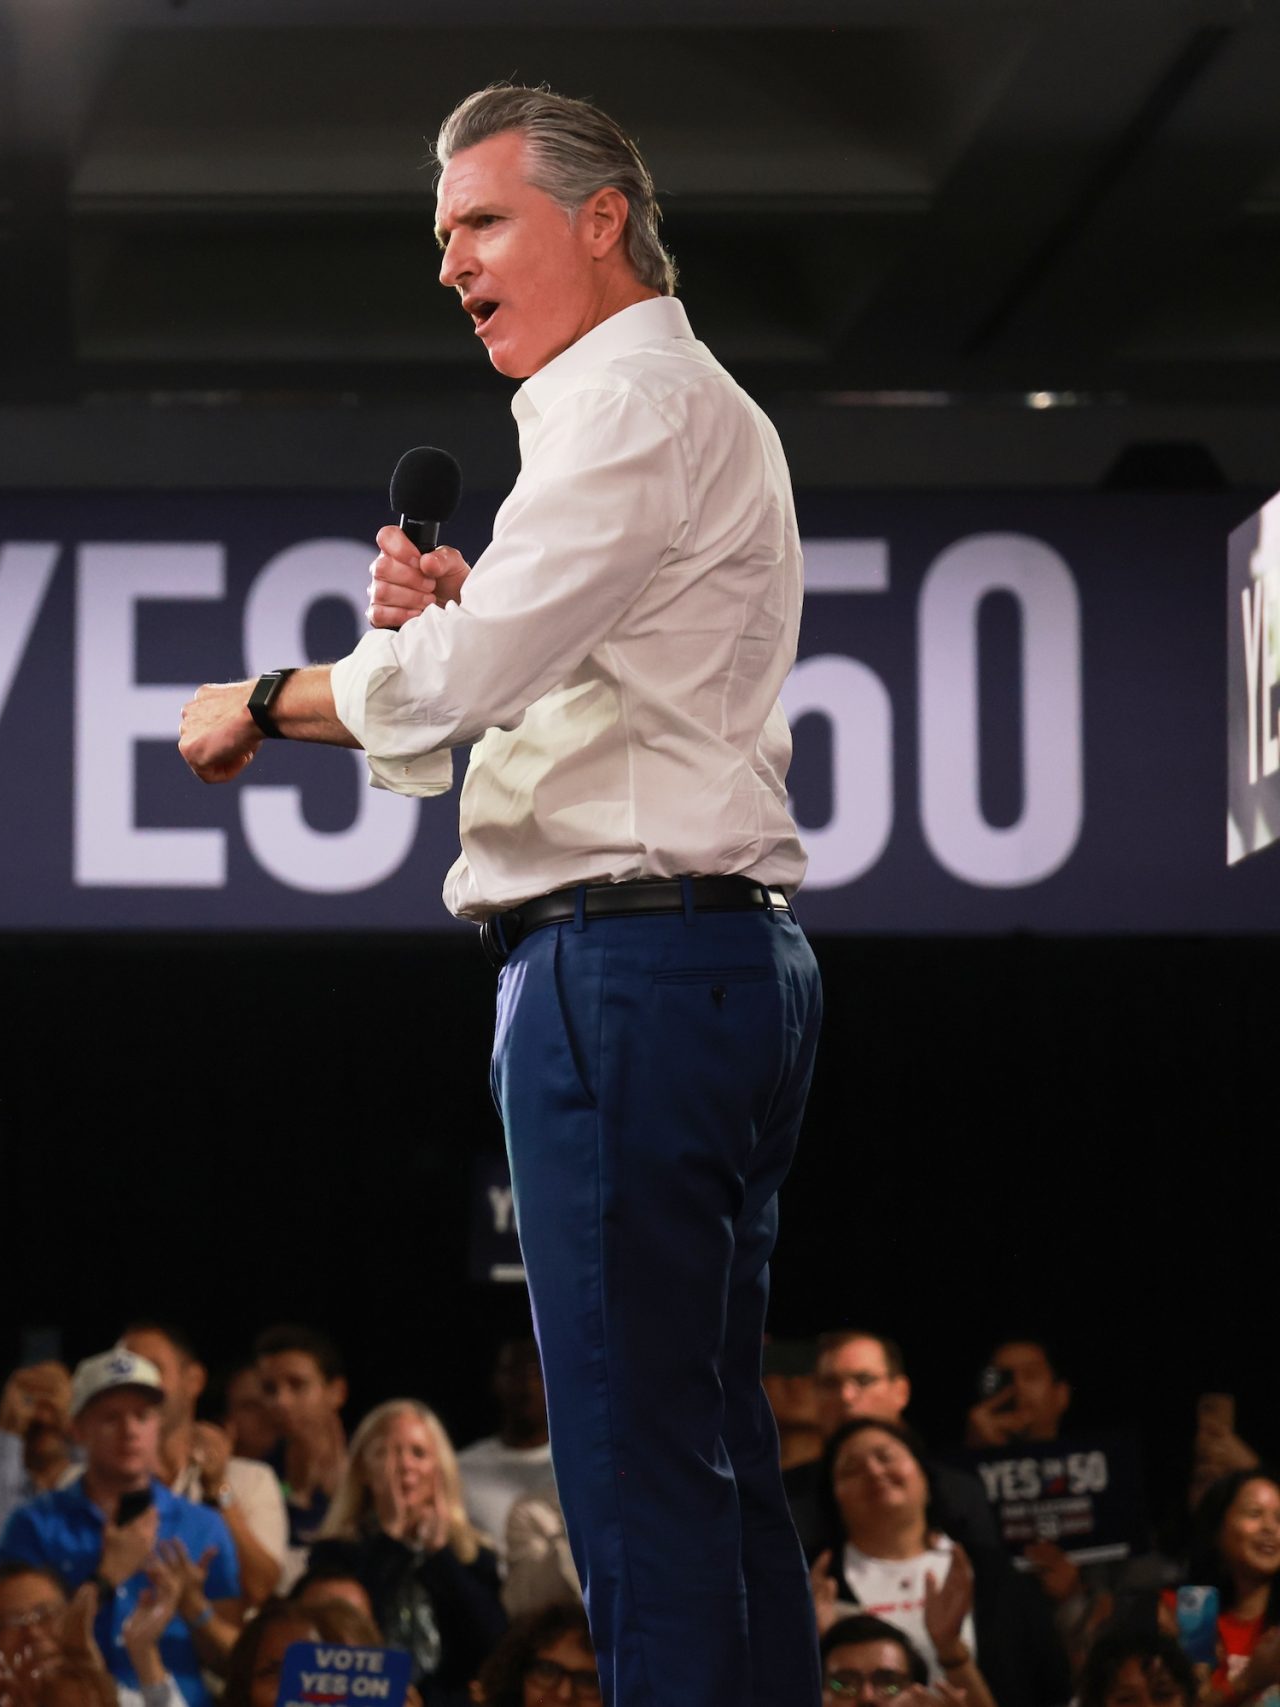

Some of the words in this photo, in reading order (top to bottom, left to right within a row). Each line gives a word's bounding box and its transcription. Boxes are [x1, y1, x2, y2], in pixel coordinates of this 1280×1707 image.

[1241, 575, 1280, 784] YE
[978, 1458, 1041, 1501] YES
[1067, 1451, 1108, 1494] 50
[315, 1649, 384, 1673] VOTE
[300, 1672, 348, 1696] YES
[351, 1676, 390, 1698] ON
